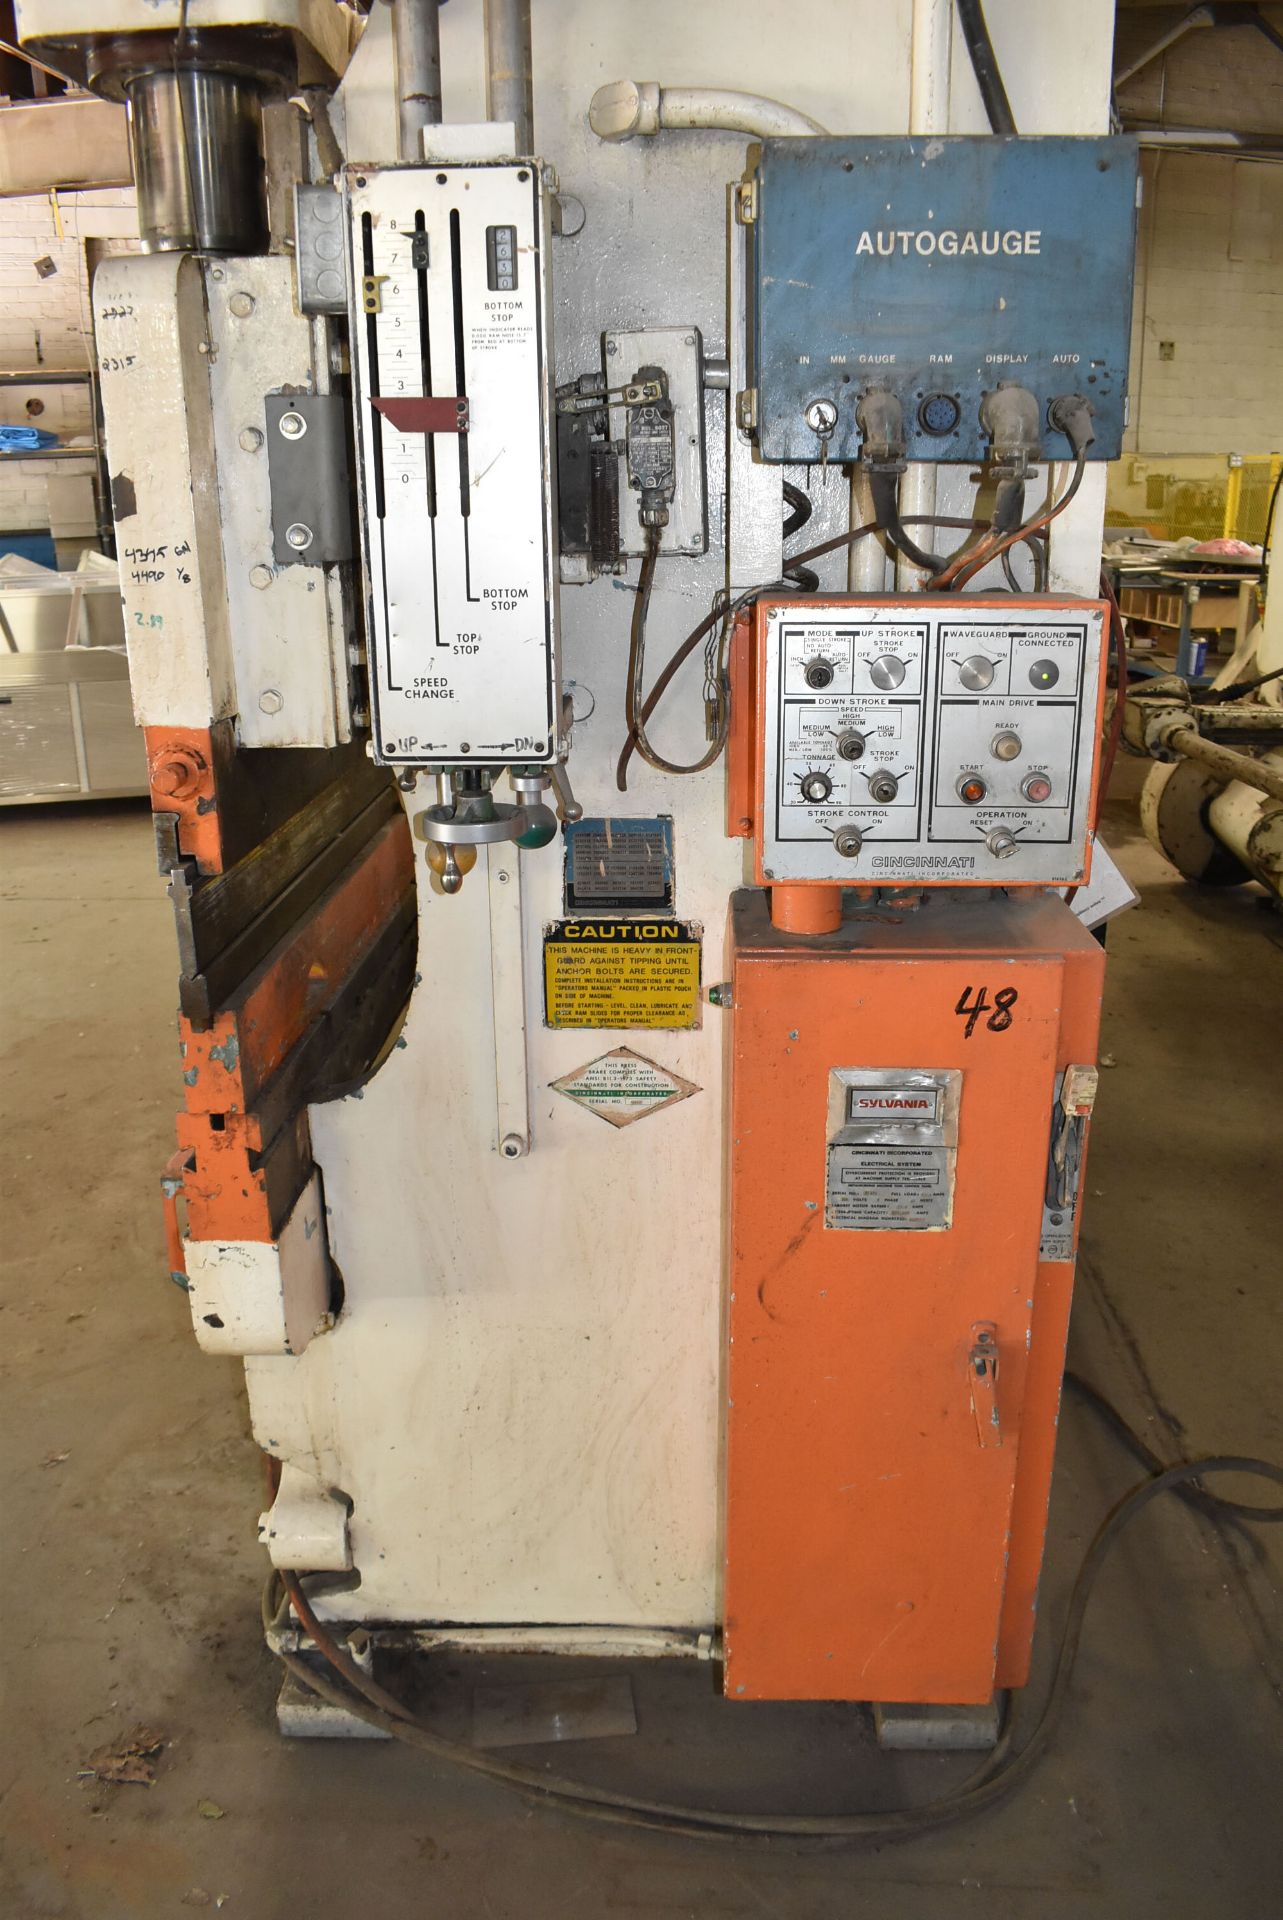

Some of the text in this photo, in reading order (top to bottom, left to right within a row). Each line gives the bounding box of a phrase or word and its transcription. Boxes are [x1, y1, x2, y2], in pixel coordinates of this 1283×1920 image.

[390, 220, 397, 230] 8
[855, 230, 1042, 255] AUTOGAUGE
[392, 254, 398, 263] 7
[393, 286, 399, 294] 6
[484, 301, 522, 310] BOTTOM
[394, 318, 400, 327] 5
[396, 350, 402, 358] 4
[986, 354, 1028, 363] DISPLAY
[1052, 354, 1080, 363] AUTO
[800, 356, 810, 364] IN
[830, 355, 846, 363] MM
[859, 355, 896, 363] GAUGE
[929, 355, 953, 363] RAM
[398, 381, 404, 390] 3
[402, 444, 406, 453] 1
[401, 474, 409, 483] 0
[483, 589, 528, 598] BOTTOM
[491, 602, 518, 610] STOP
[456, 634, 477, 643] TOP
[453, 646, 480, 655] STOP
[413, 678, 448, 687] SPEED
[404, 690, 455, 699] CHANGE
[398, 736, 418, 751] UP
[515, 738, 534, 752] DN
[872, 856, 975, 868] CINCINNATI
[564, 926, 679, 938] CAUTION
[955, 986, 1018, 1040] 48
[859, 1099, 928, 1108] SYLVANIA
